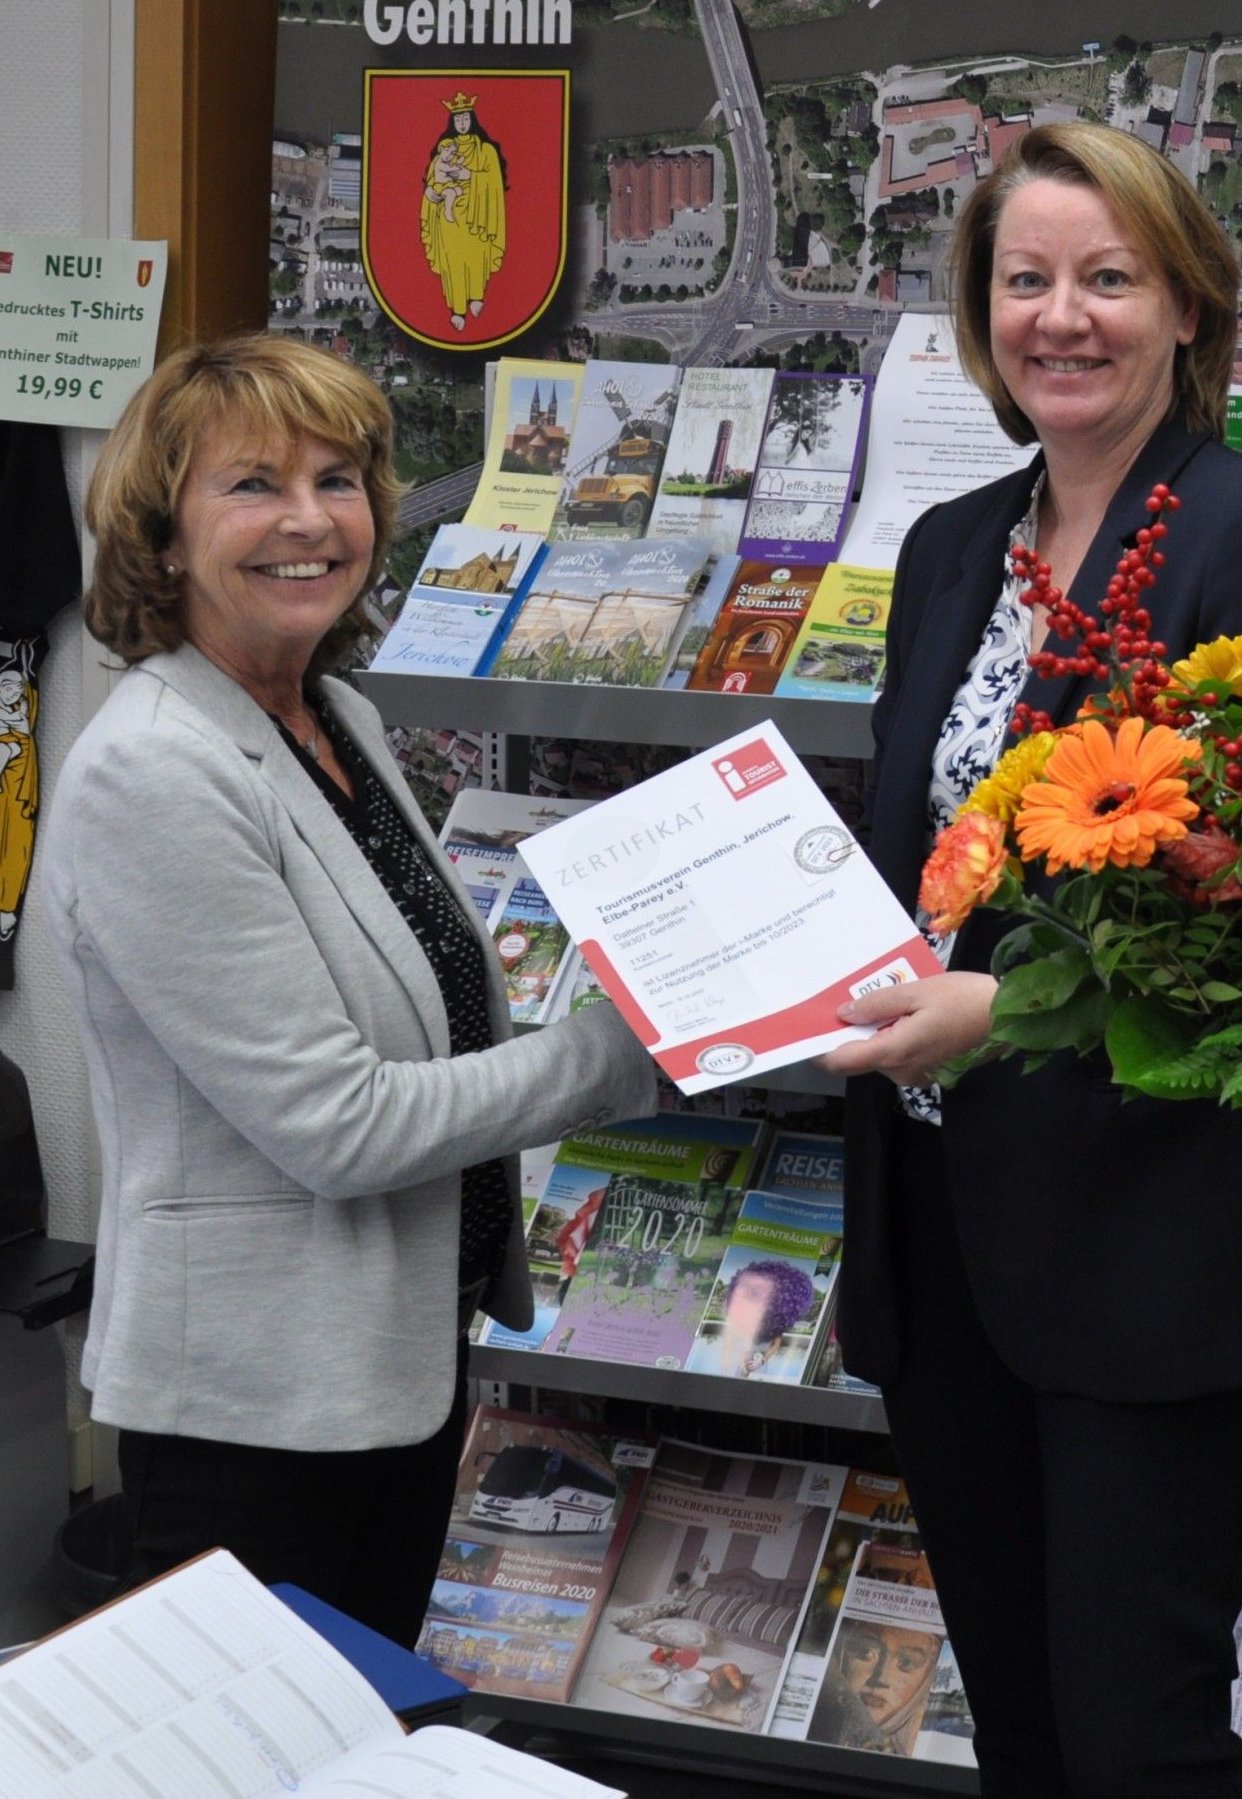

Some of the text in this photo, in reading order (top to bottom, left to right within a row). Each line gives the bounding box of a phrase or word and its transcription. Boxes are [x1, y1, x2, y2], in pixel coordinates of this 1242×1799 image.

[45, 254, 102, 279] NEU!
[70, 300, 144, 321] T-Shirts
[56, 330, 79, 343] mit
[54, 352, 141, 371] Stadtwappen!
[17, 374, 103, 400] 19,99 €
[687, 383, 748, 392] RESTAURANT
[690, 373, 721, 381] HOTEL
[739, 583, 810, 597] Straße der
[733, 595, 805, 609] Romanik
[555, 802, 705, 887] ZERTIFIKAT
[596, 812, 796, 914] Tourismusverein Genthin, Jerichow,
[602, 881, 689, 925] Elbe-Parey e.V.
[649, 915, 686, 936] Genthin
[773, 913, 791, 927] und
[664, 968, 706, 989] Nutzung
[858, 978, 881, 997] DTV
[708, 1055, 733, 1069] DTV
[572, 1132, 692, 1160] GARTENTRÄUME
[616, 1206, 705, 1259] 2020
[492, 1573, 596, 1600] Busreisen 2020
